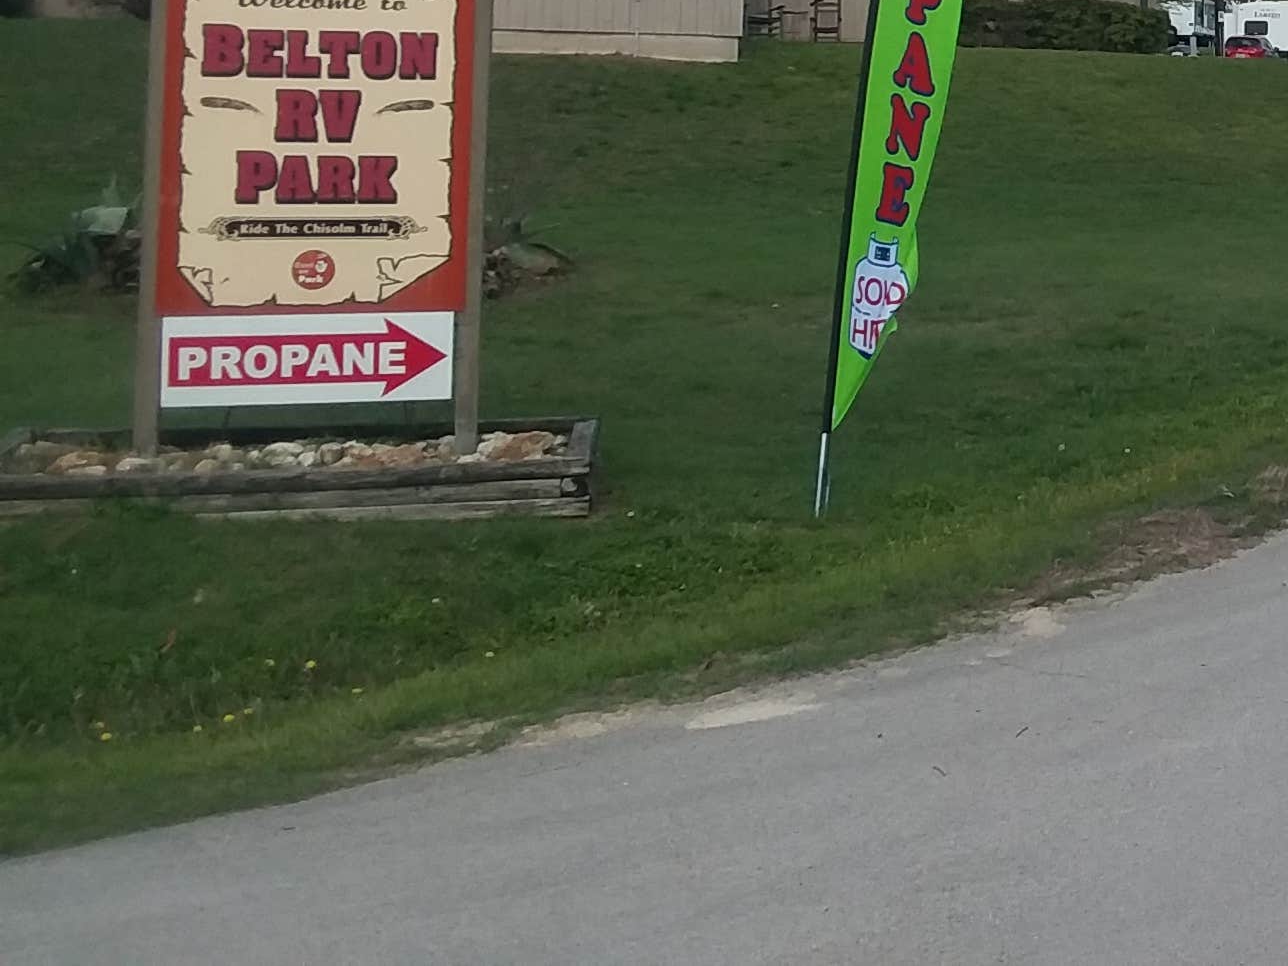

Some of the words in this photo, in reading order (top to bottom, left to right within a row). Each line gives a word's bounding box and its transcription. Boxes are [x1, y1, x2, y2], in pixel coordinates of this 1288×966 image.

[201, 23, 439, 81] BELTON
[273, 88, 362, 143] RV
[234, 150, 399, 204] PARK
[240, 223, 270, 234] Ride
[274, 223, 298, 234] The
[303, 223, 356, 234] Chisolm
[360, 223, 388, 234] Trail
[177, 340, 408, 381] PROPANE
